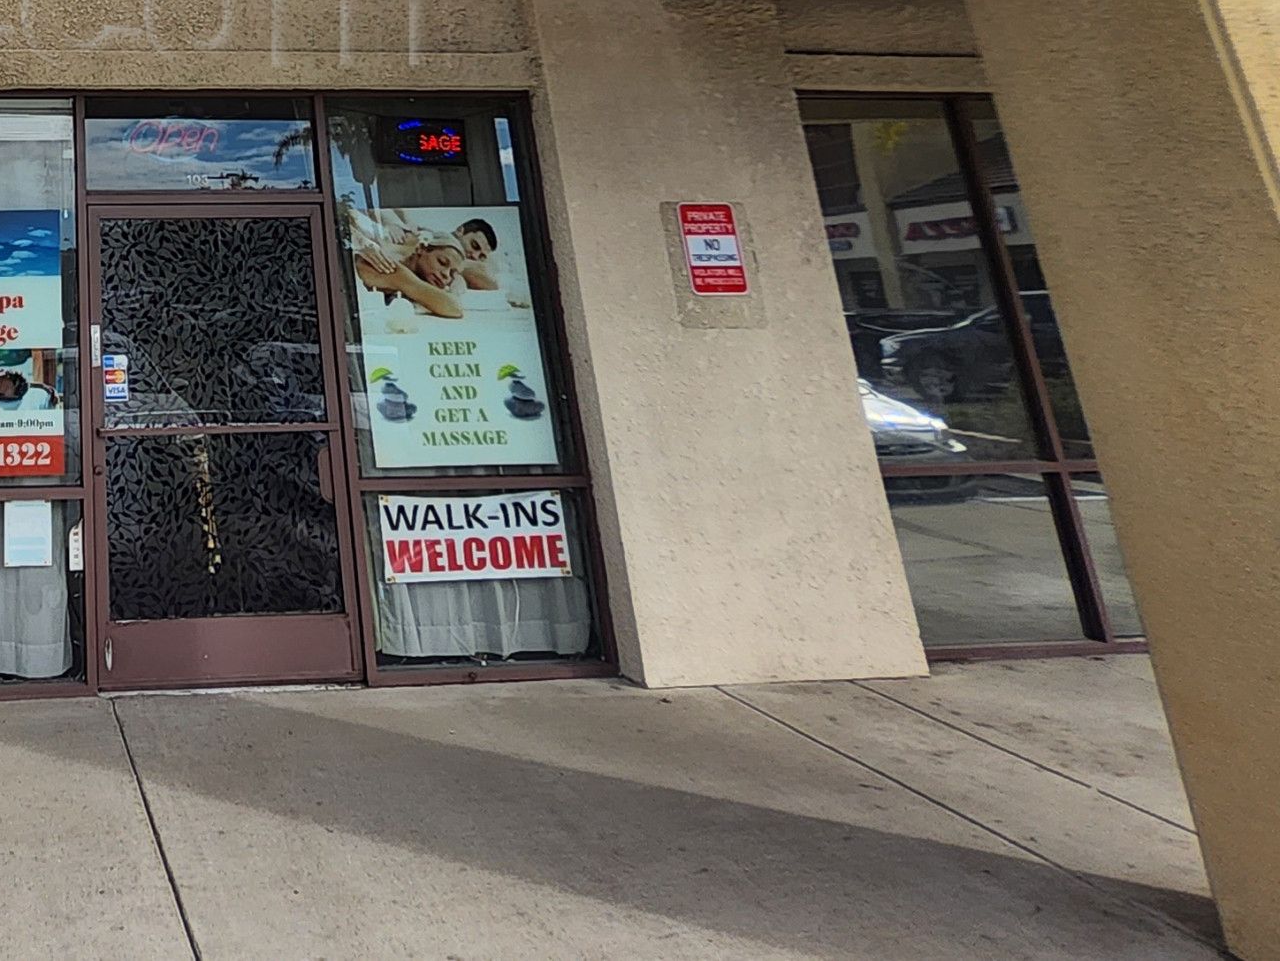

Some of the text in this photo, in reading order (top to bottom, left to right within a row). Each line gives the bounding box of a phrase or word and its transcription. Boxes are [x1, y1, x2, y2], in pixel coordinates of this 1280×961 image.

[128, 119, 220, 155] Open
[419, 134, 462, 152] SAGE
[703, 239, 721, 251] NO
[428, 341, 477, 356] KEEP
[429, 363, 482, 378] CALM
[107, 386, 126, 394] VISA
[440, 386, 478, 400] AND
[434, 408, 489, 423] GET A
[422, 430, 508, 447] MASSAGE
[382, 499, 561, 531] WALK-INS
[386, 534, 568, 574] WELCOME
